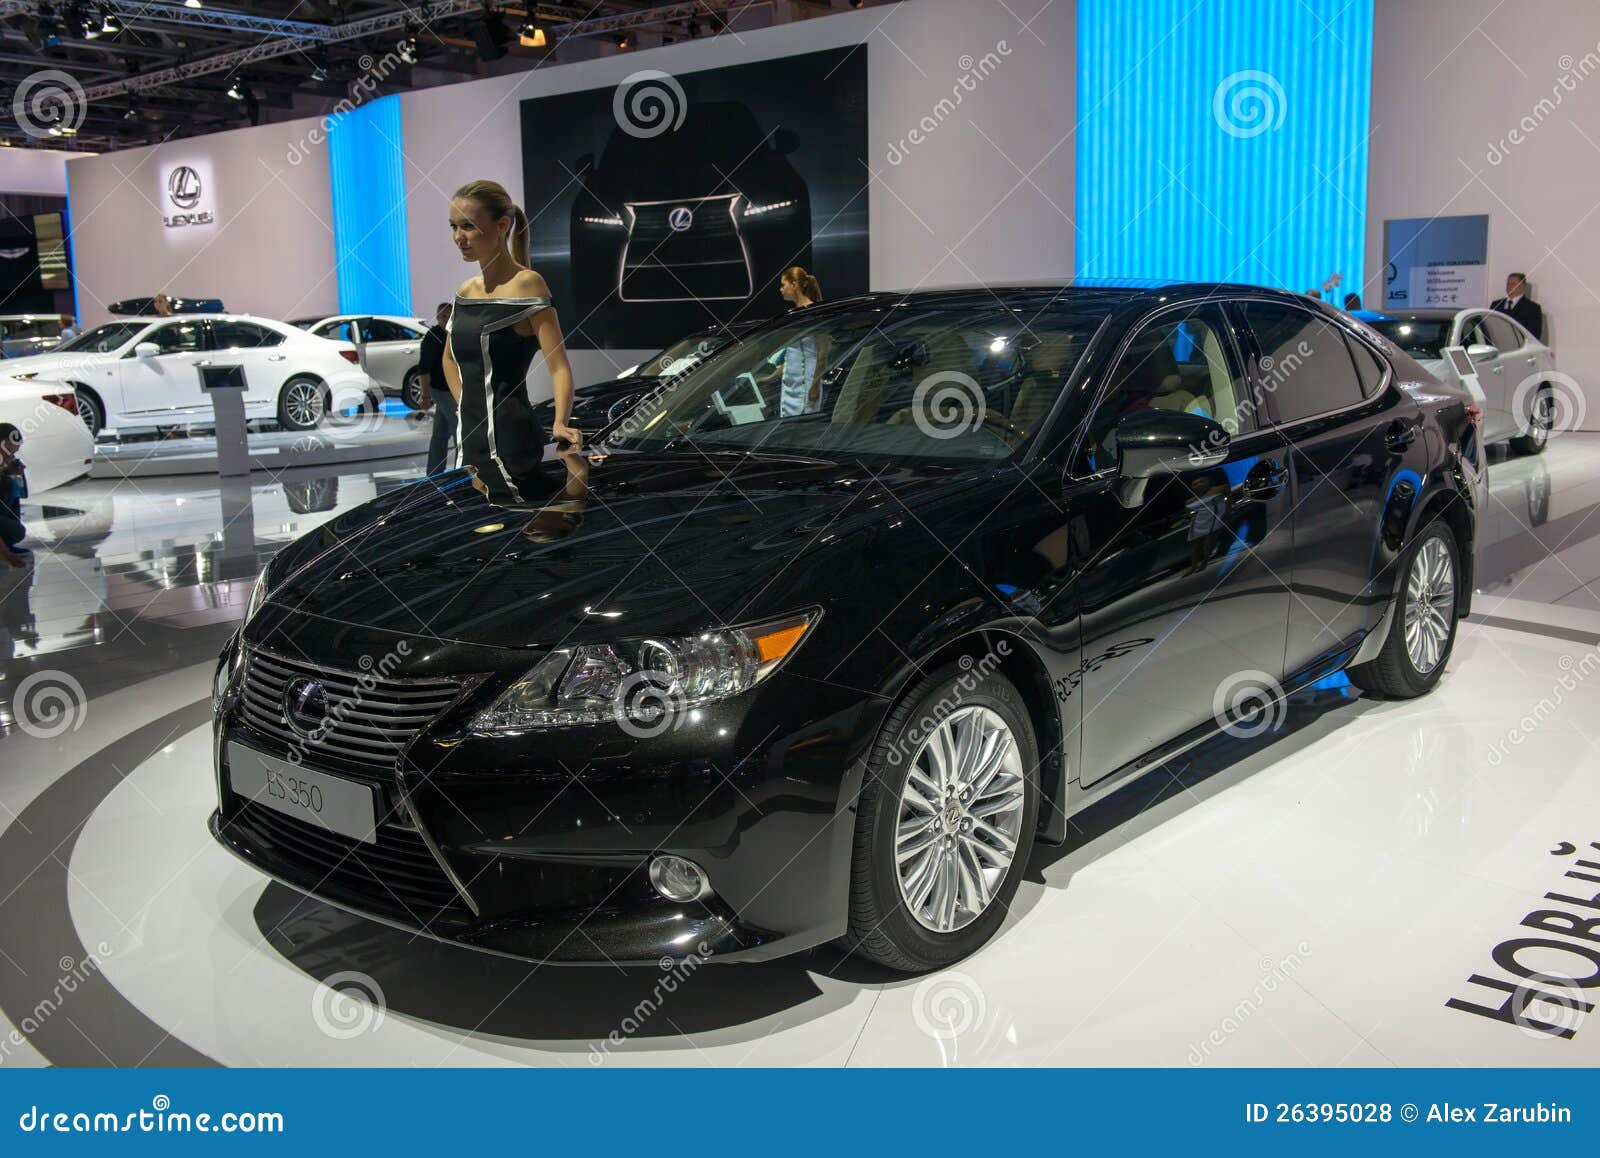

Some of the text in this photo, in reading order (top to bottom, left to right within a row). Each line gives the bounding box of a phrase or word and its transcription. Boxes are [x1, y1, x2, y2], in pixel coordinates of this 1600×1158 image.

[266, 769, 323, 813] ES 350
[1444, 841, 1600, 1040] НОВ
